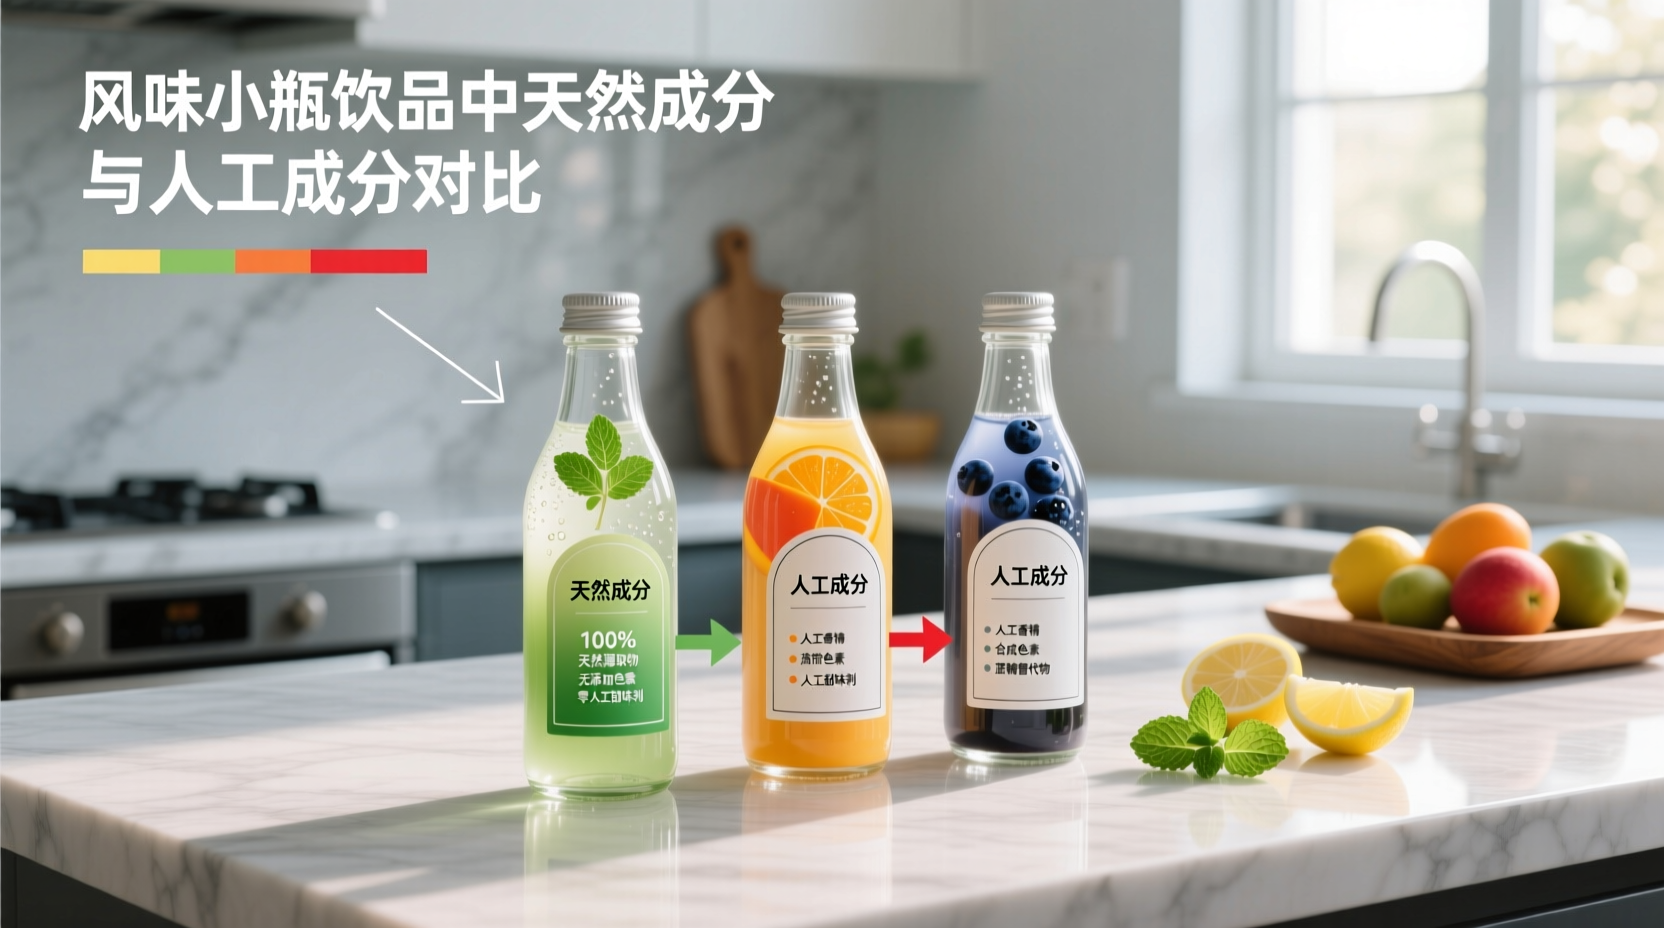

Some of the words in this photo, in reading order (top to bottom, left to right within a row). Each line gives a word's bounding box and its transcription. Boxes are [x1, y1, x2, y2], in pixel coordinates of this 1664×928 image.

[790, 573, 869, 596] 人工成分
[990, 565, 1068, 587] 人工成分
[570, 579, 651, 601] 天然成分
[580, 630, 637, 650] 100%
